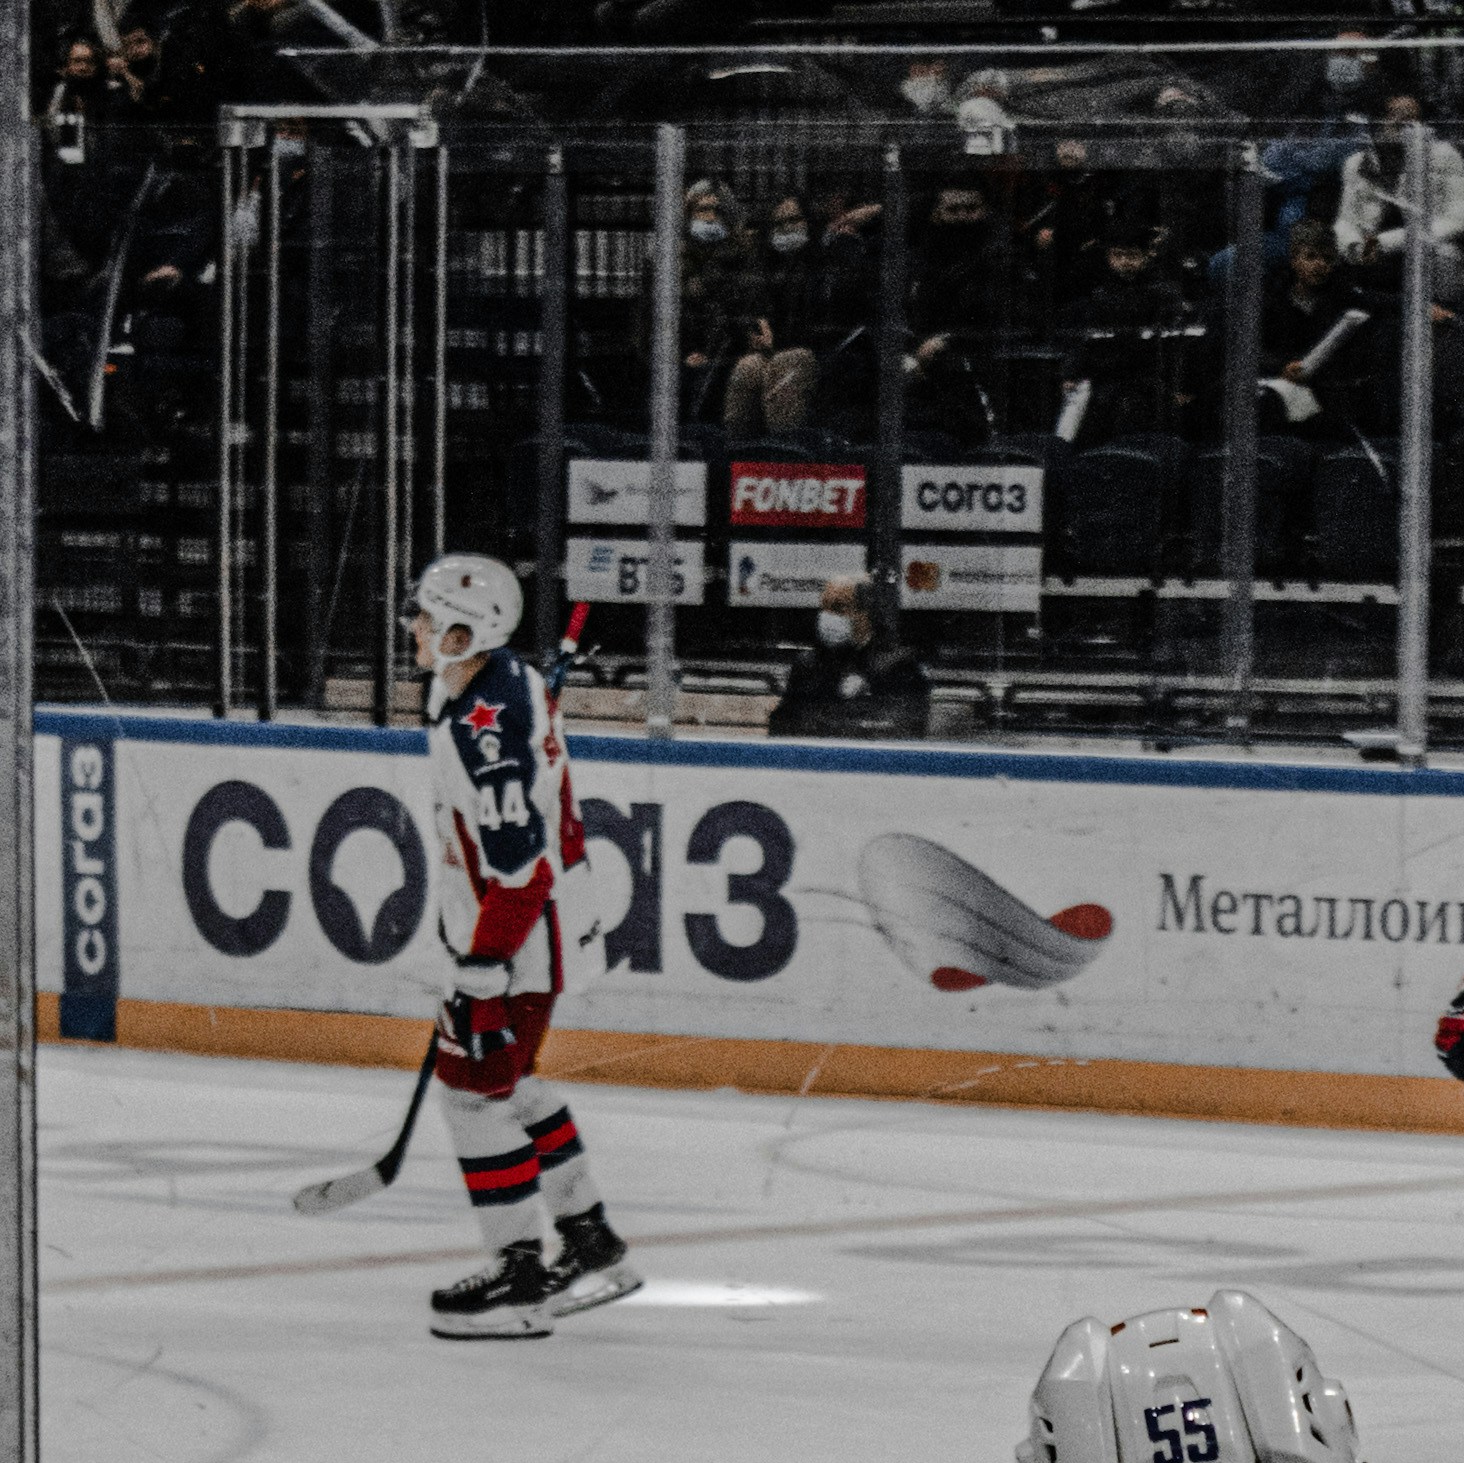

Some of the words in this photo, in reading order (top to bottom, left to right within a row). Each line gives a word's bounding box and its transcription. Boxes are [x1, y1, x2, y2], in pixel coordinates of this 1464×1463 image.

[734, 476, 865, 514] FONBET
[478, 779, 530, 831] 44
[182, 779, 797, 983] соаз
